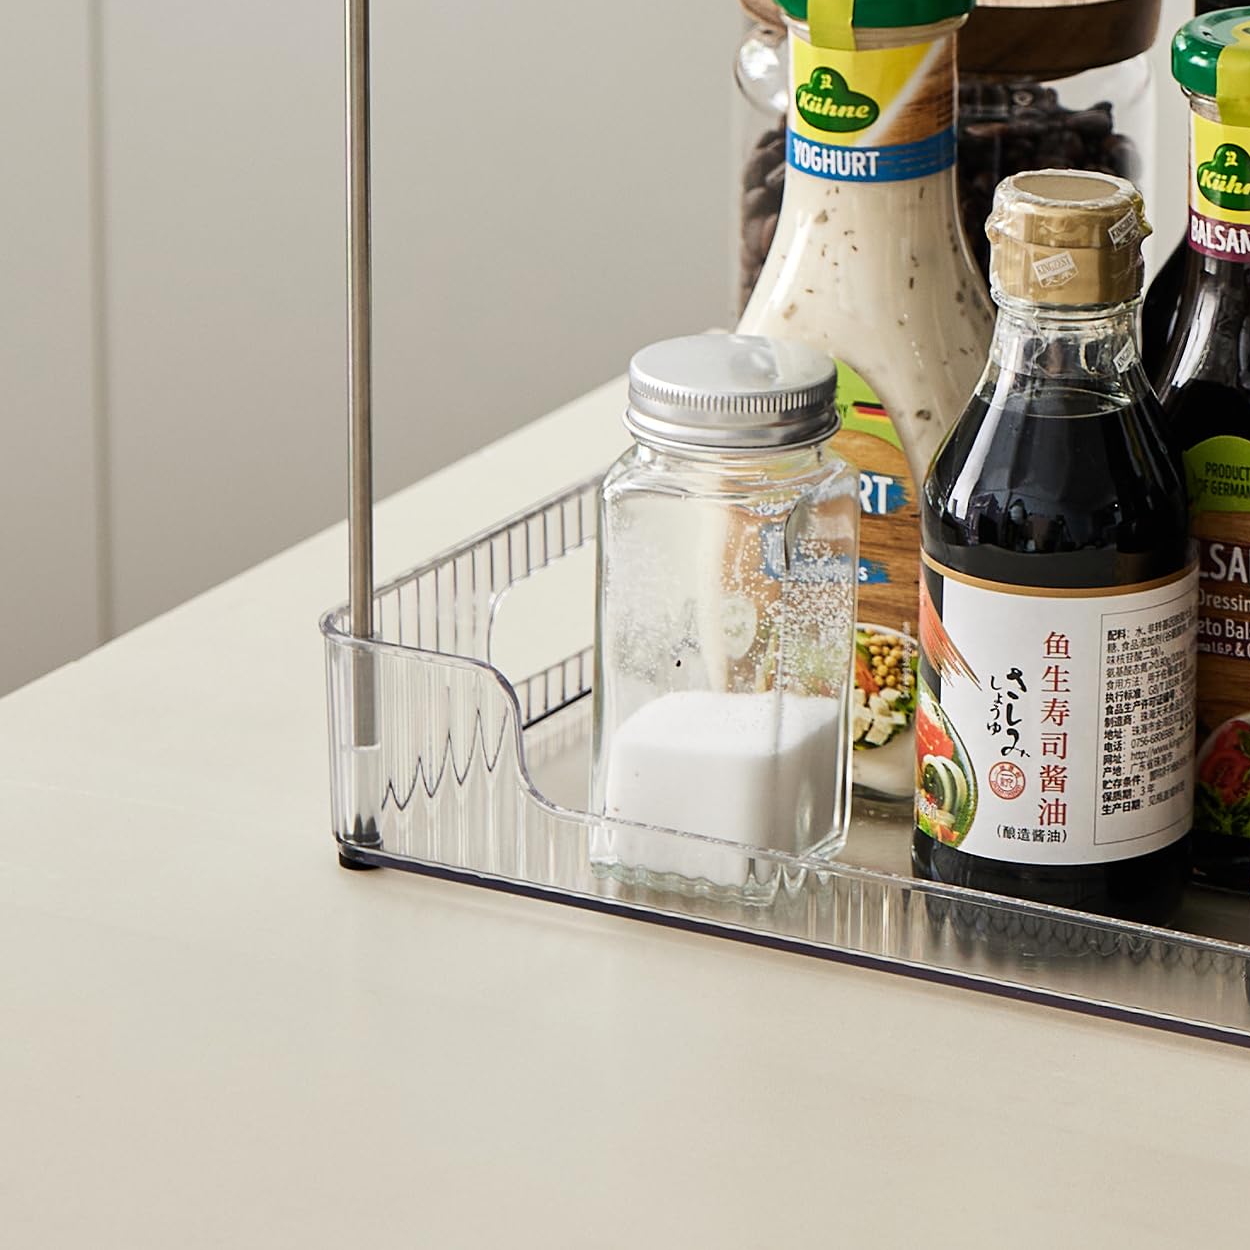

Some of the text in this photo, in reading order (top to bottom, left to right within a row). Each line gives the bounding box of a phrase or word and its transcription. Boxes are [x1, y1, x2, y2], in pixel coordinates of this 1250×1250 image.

[798, 91, 870, 120] Kühne
[792, 138, 880, 177] YOGHURT
[1205, 461, 1250, 483] PRODUCT
[1038, 630, 1072, 828] 鱼生寿司酱油
